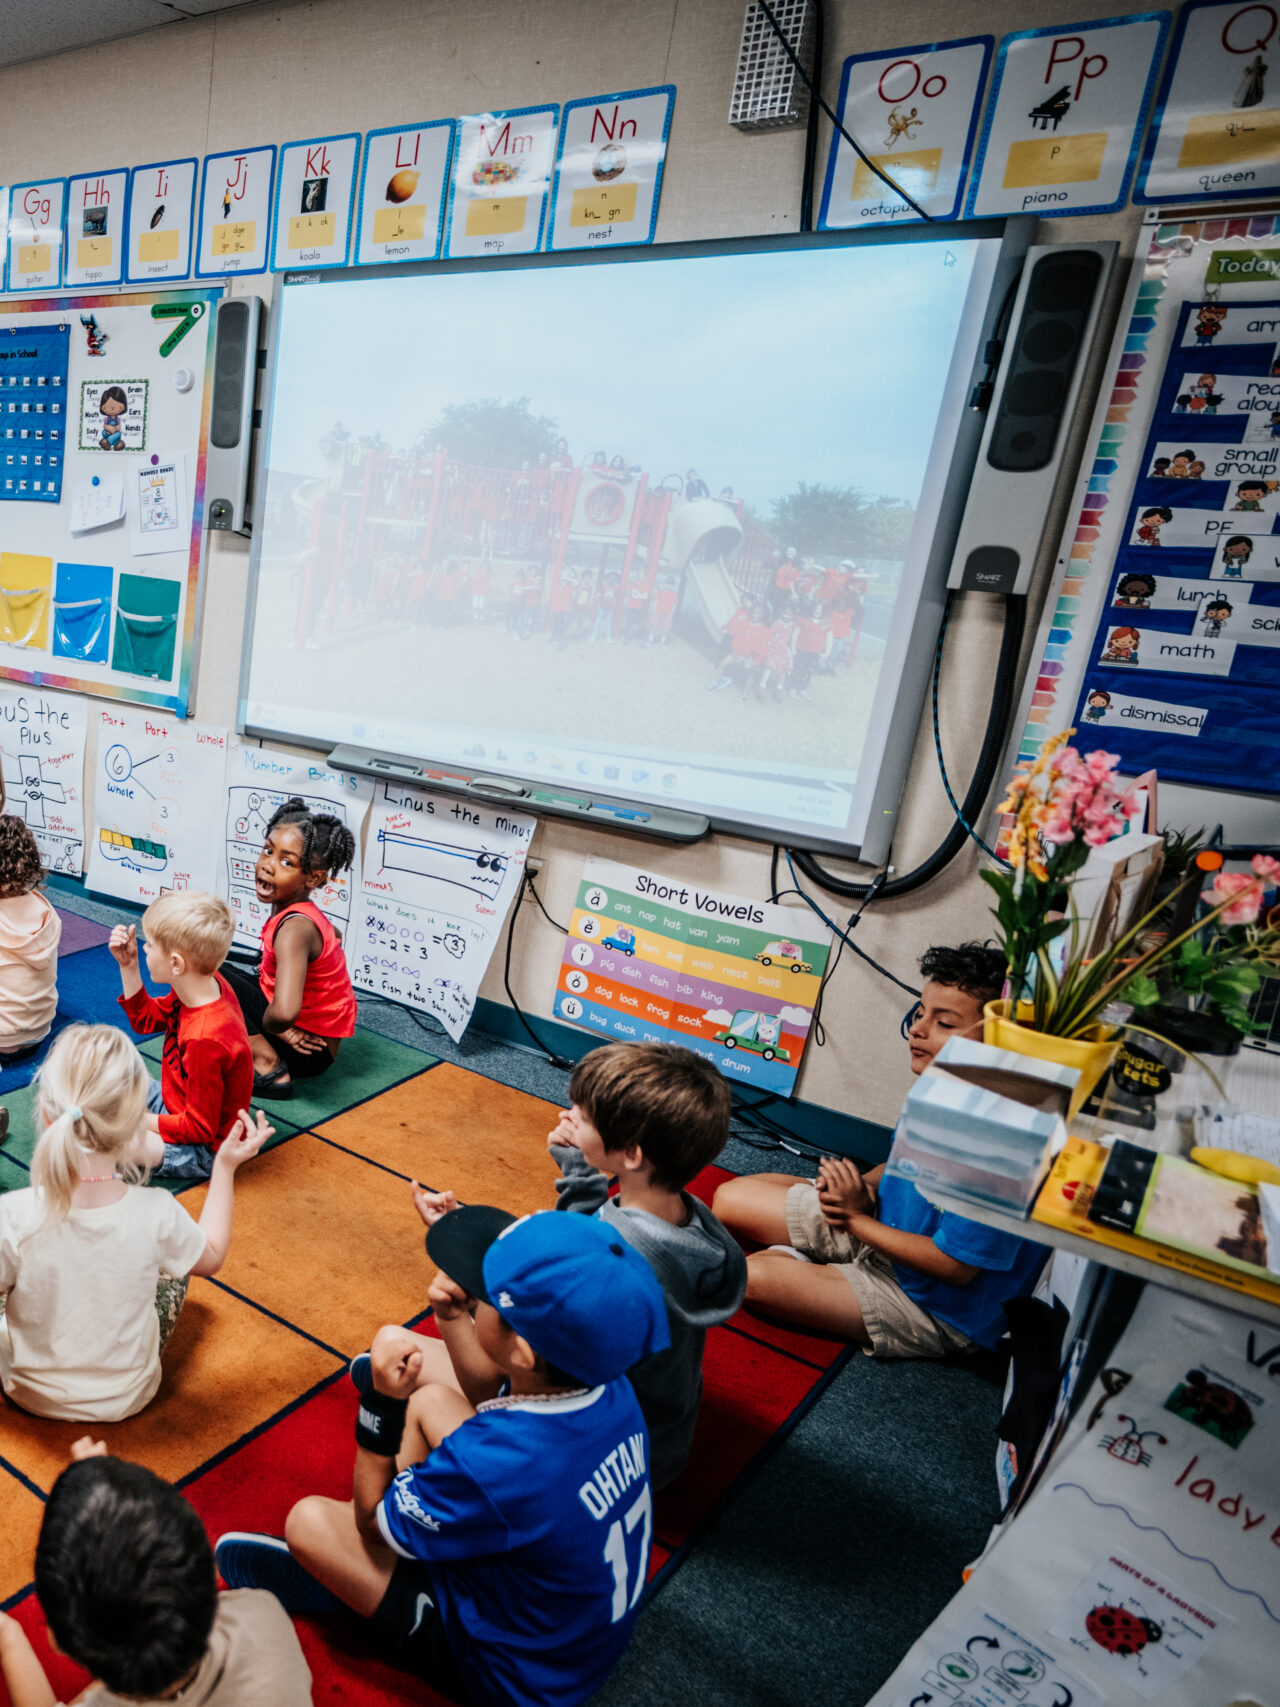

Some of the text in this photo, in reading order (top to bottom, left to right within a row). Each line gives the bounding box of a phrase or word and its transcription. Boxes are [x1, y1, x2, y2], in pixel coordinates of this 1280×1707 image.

[1044, 36, 1108, 101] Pp
[877, 60, 947, 104] Oo
[590, 105, 638, 144] Nn
[395, 133, 420, 168] Ll
[477, 121, 533, 160] Mm
[304, 146, 331, 179] Kk
[1050, 144, 1061, 160] p
[155, 169, 169, 198] Ii
[226, 157, 248, 200] Jj
[1199, 170, 1256, 192] queen
[83, 179, 111, 207] Hh
[1022, 189, 1068, 210] piano
[23, 188, 51, 225] Gg
[588, 226, 613, 241] nest
[299, 250, 320, 261] koala
[384, 244, 410, 257] lemon
[484, 239, 505, 252] map
[147, 263, 169, 273] insect
[222, 257, 241, 271] jump
[85, 270, 103, 281] hippo
[17, 349, 39, 358] School
[86, 387, 99, 396] Eyes
[128, 386, 143, 394] Brain
[86, 427, 99, 436] Body
[125, 424, 141, 432] Hands
[1224, 447, 1279, 462] small
[1215, 460, 1276, 479] group
[975, 572, 1002, 582] SMART
[1160, 643, 1215, 660] math
[34, 699, 71, 730] the
[101, 712, 126, 729] Part
[1120, 705, 1205, 729] dismissal
[19, 726, 52, 746] Plus
[145, 721, 168, 739] Part
[112, 753, 175, 775] 6 3
[244, 750, 358, 792] Number Bonds
[160, 806, 169, 819] 3
[384, 781, 532, 842] Linus the minus
[635, 875, 765, 924] Short Vowels
[395, 906, 417, 921] does
[614, 903, 740, 947] ant nap hat van yam
[368, 932, 428, 960] 5 2 3
[450, 940, 459, 951] 3
[599, 958, 724, 1006] pig dish fish bib king
[691, 958, 715, 971] web
[722, 965, 749, 981] nest
[757, 974, 782, 990] belt
[594, 985, 703, 1029] dog lock frog sock
[589, 1011, 752, 1074] bug duck run drum
[394, 1466, 441, 1532] Dodgers
[603, 1481, 653, 1624] 17
[1108, 1556, 1143, 1580] PARTS
[1165, 1593, 1217, 1630] LADYBUG
